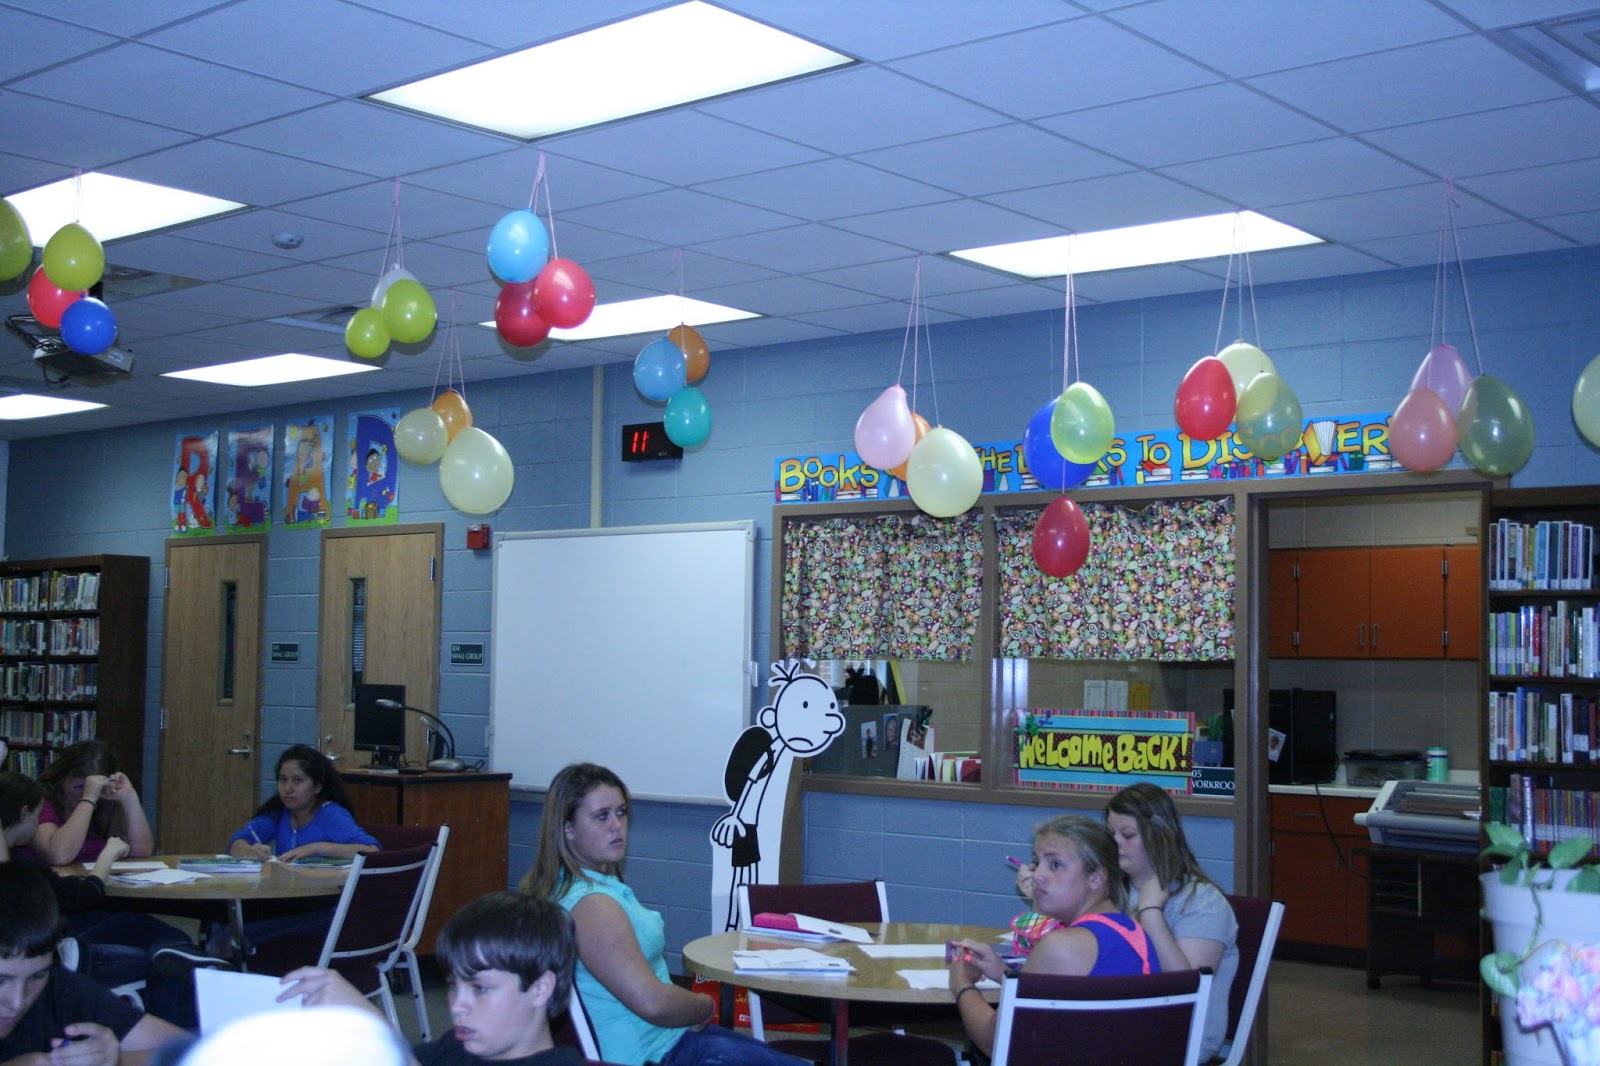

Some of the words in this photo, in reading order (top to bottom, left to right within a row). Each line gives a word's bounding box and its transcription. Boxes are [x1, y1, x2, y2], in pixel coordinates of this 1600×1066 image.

[1178, 415, 1392, 469] DISCOVER
[452, 652, 465, 660] SMALL
[465, 652, 482, 660] GROUP
[1191, 769, 1202, 778] 05
[1191, 779, 1235, 790] ORKROO
